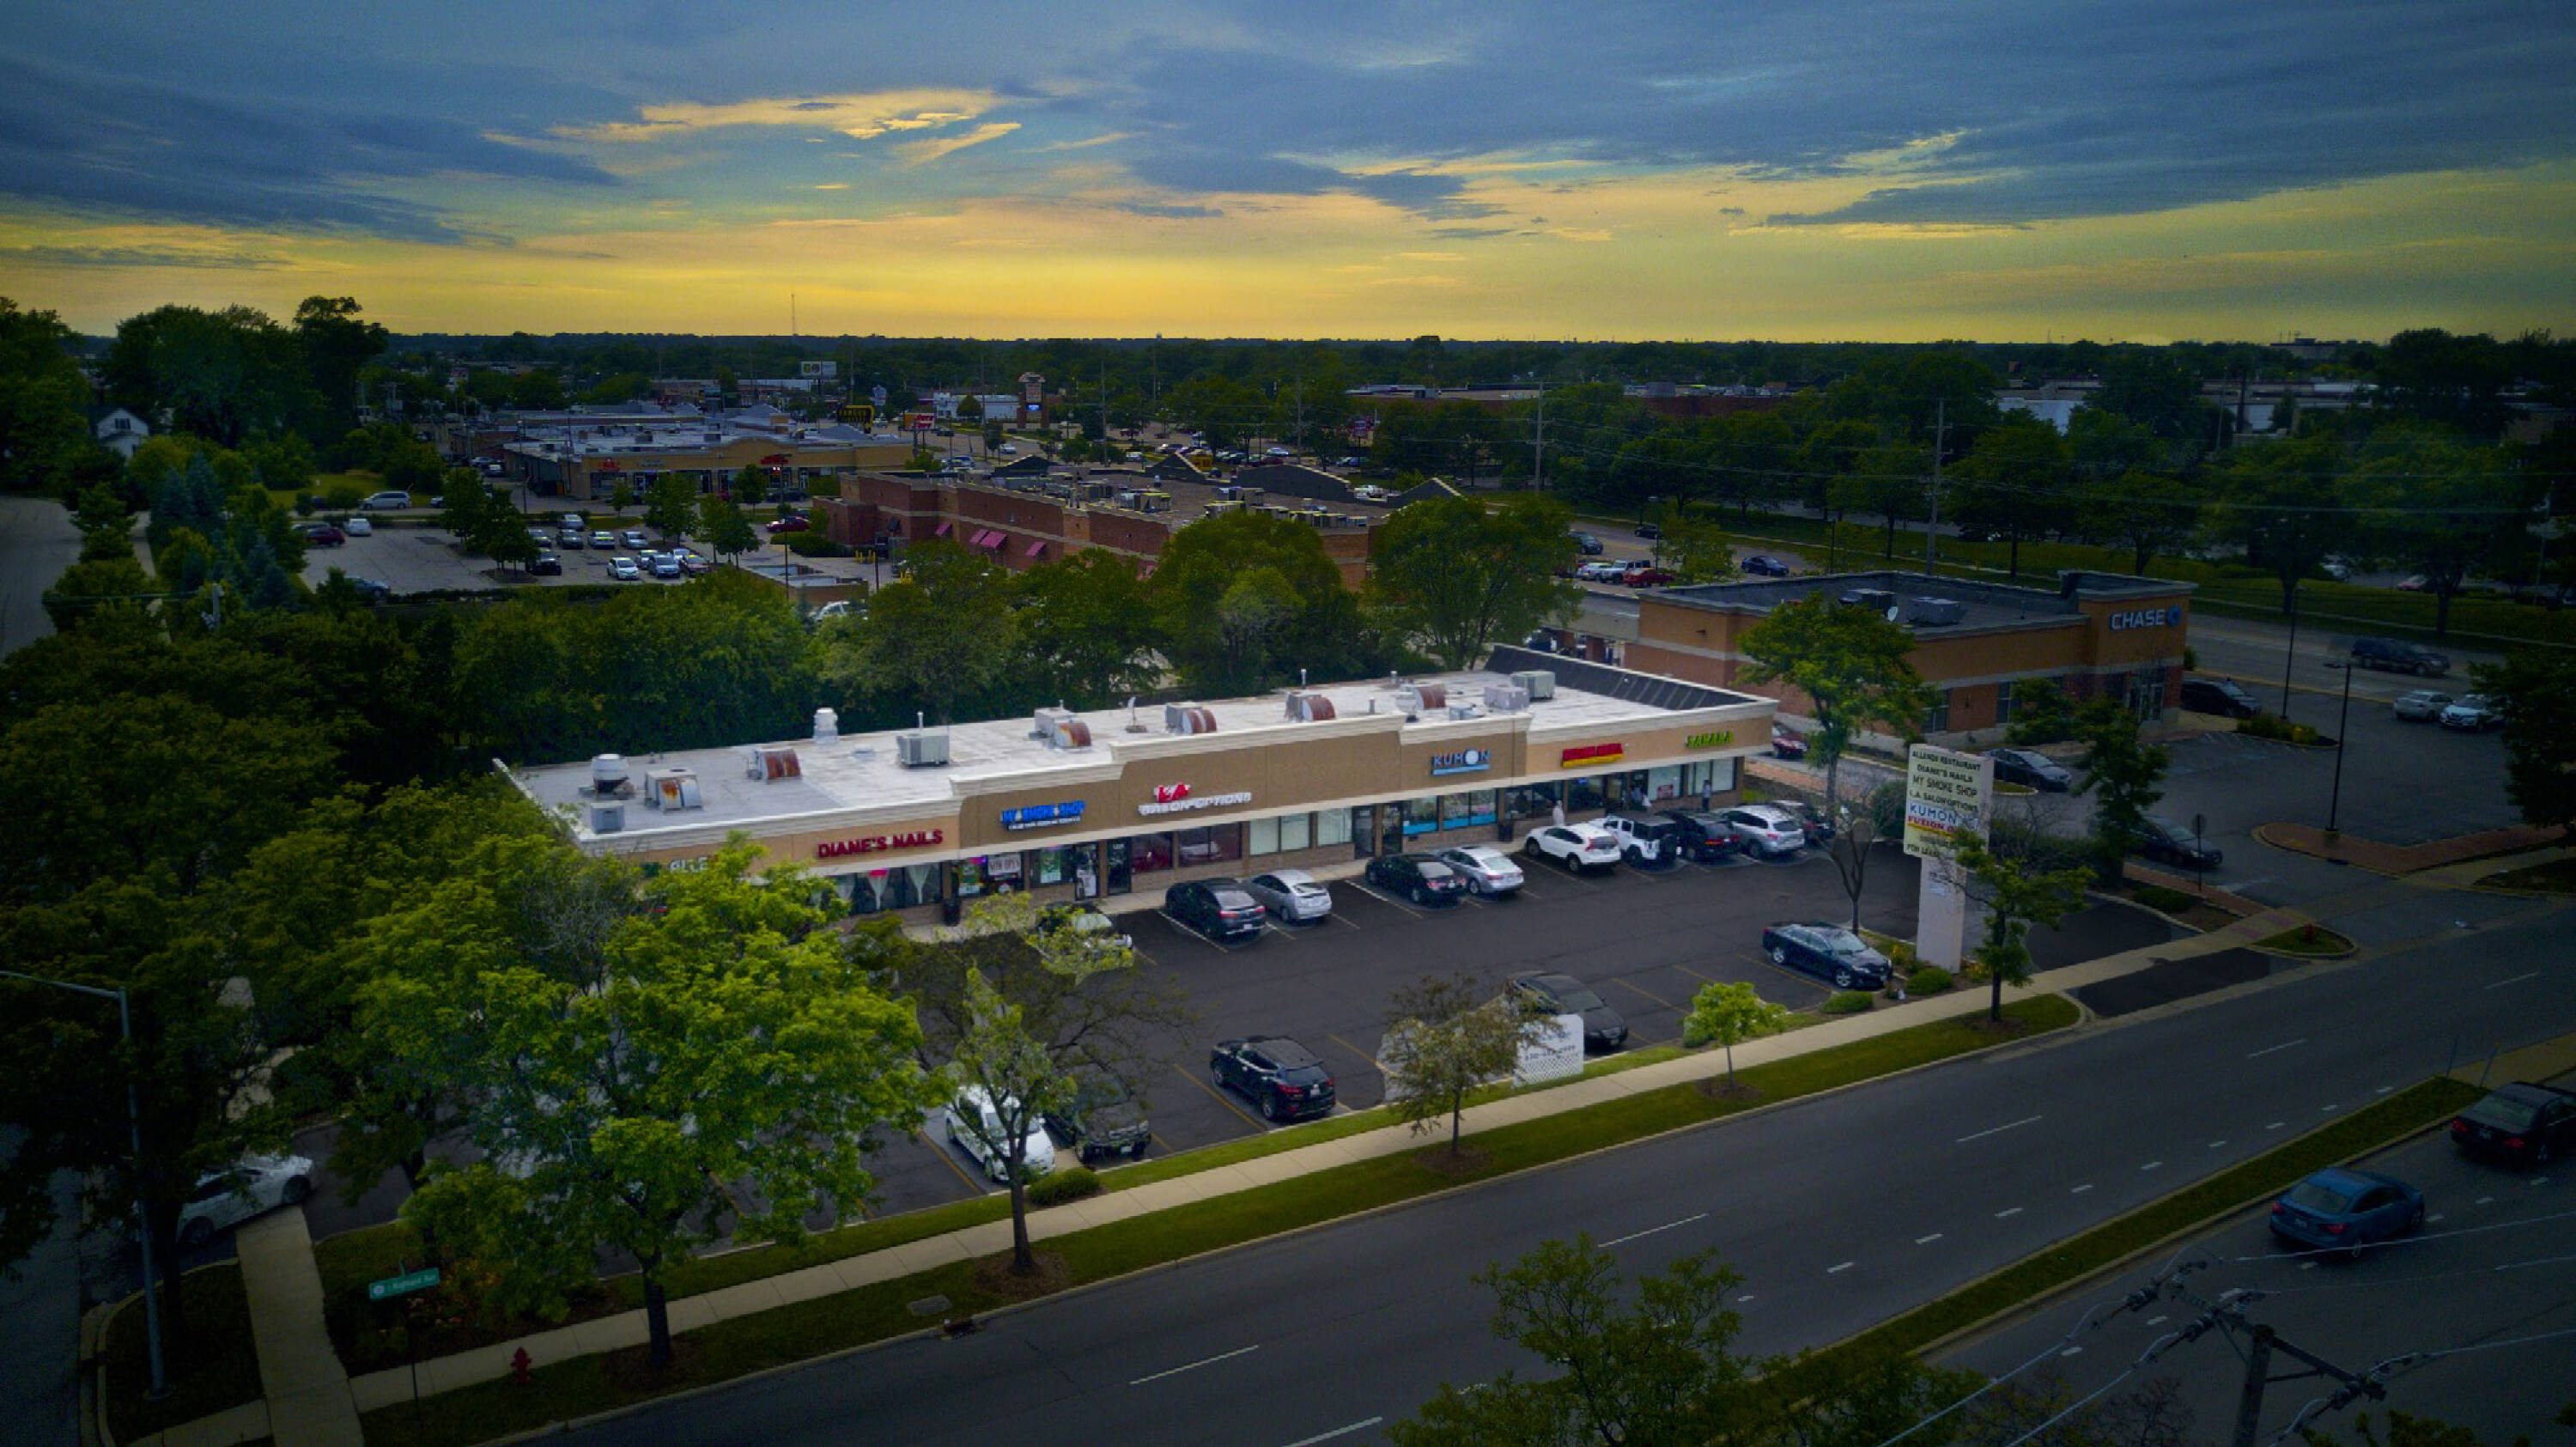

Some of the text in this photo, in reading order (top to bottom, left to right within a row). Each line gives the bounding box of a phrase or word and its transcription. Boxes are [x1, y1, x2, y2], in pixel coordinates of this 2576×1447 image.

[2110, 609, 2166, 630] CHASE
[1432, 749, 1491, 767] KUMON
[1910, 803, 1957, 824] KUMON
[817, 829, 943, 859] DIANE'S NAILS
